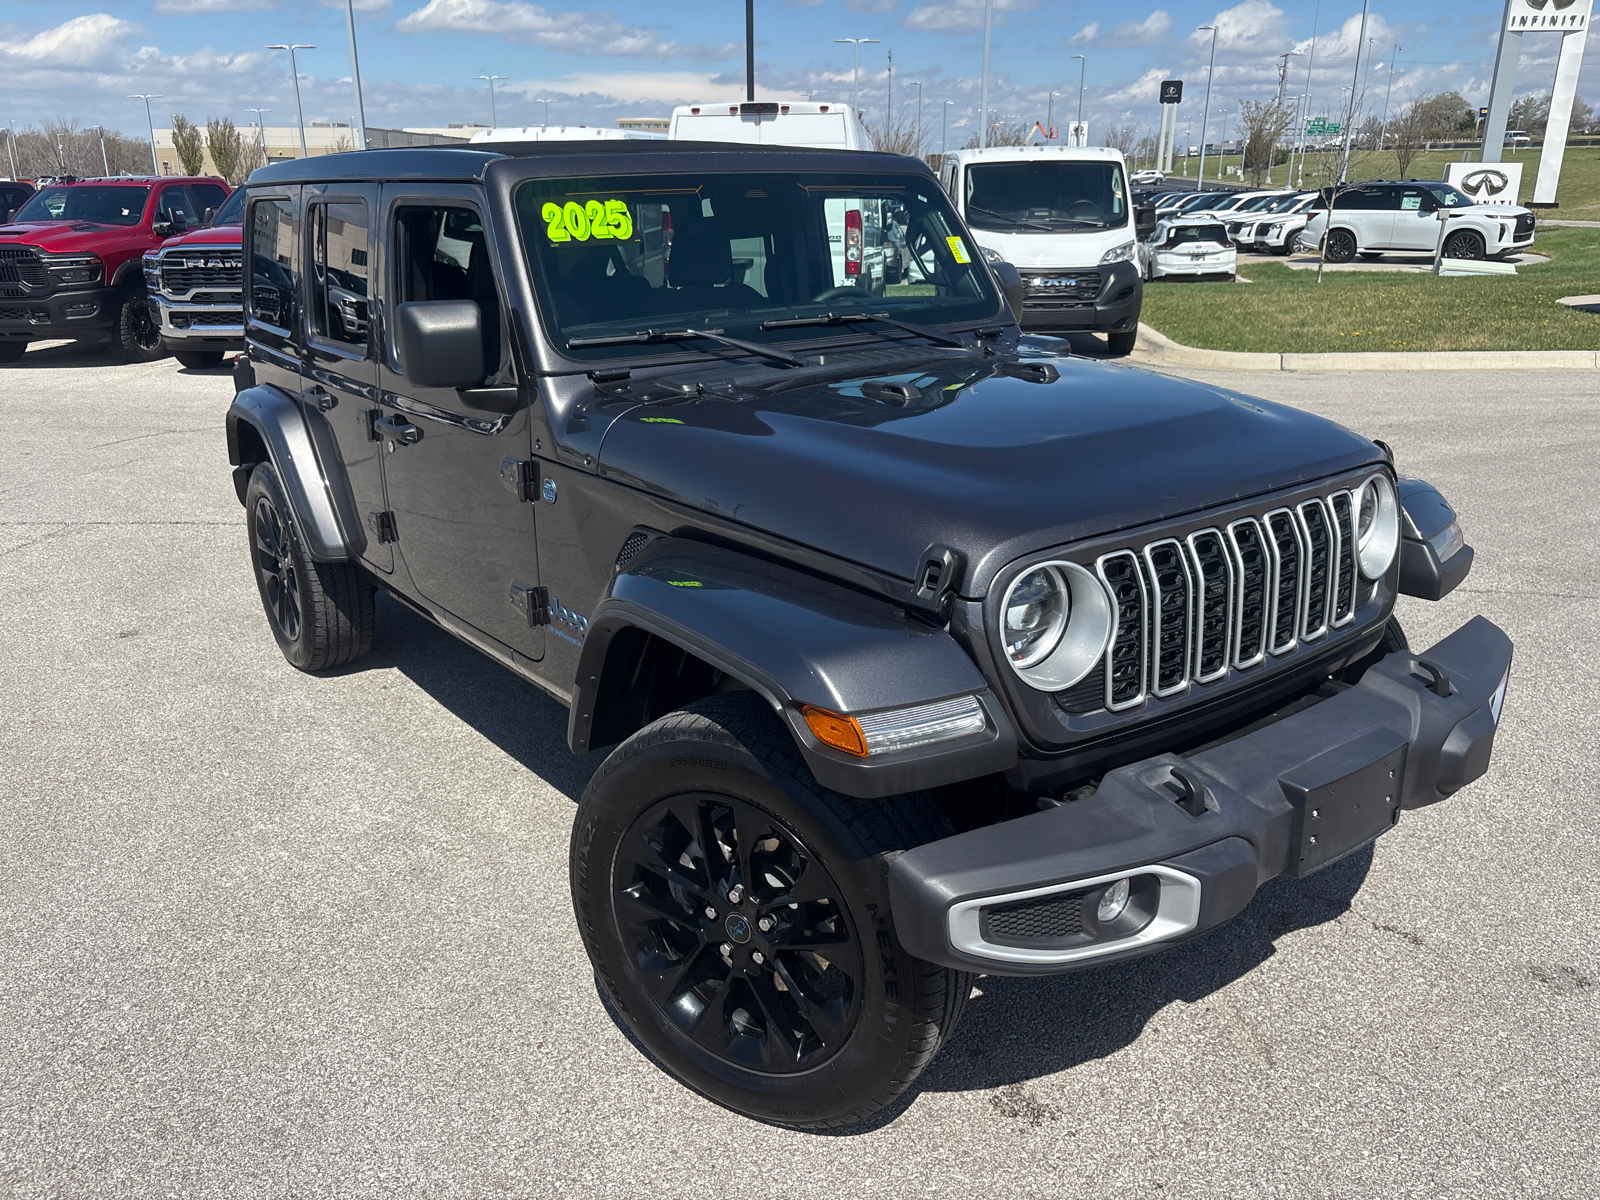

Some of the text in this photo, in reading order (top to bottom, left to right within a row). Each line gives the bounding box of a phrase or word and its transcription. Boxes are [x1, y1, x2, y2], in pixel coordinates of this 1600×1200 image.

[1511, 15, 1585, 27] INFINITI
[541, 199, 633, 243] 2025
[1028, 278, 1077, 287] RAM
[546, 596, 589, 639] Jeep
[865, 902, 900, 1025] NEXEN
